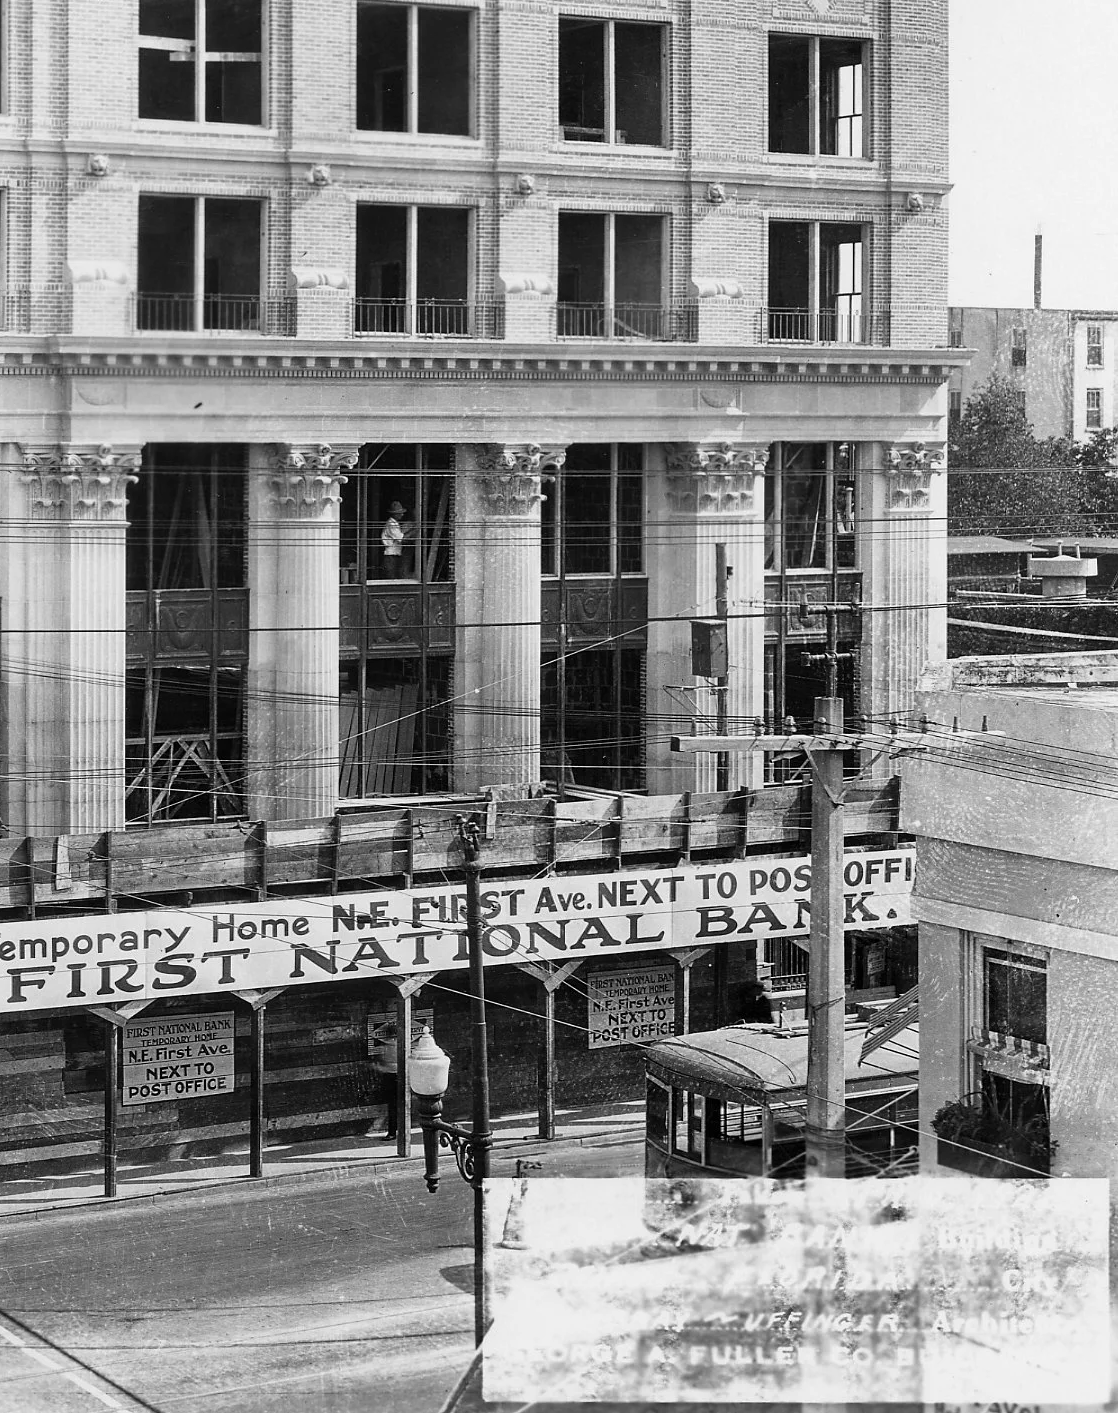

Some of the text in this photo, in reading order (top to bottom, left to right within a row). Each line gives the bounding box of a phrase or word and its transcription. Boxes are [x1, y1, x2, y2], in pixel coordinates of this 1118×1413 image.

[212, 913, 311, 943] Home
[332, 900, 400, 933] N.E.
[412, 889, 525, 928] FIRST
[534, 886, 593, 914] Ave.
[597, 876, 685, 908] NEXT
[695, 871, 738, 900] TO
[749, 864, 811, 896] POS
[843, 857, 912, 887] OFFI
[6, 947, 251, 1004] FIRST
[289, 913, 665, 978] NATIONAL
[590, 972, 674, 989] FIRST NATIONAL BAN
[606, 984, 670, 998] TEMPORARY HOME
[593, 1000, 616, 1013] N.E.
[618, 996, 650, 1010] First
[608, 1009, 666, 1026] NEXT TO
[126, 1020, 232, 1038] FIRST NATIONAL BANK
[593, 1021, 675, 1043] POST OFFICE
[142, 1033, 217, 1047] TEMPORARY HOME
[129, 1050, 153, 1063] N.E.
[156, 1045, 192, 1060] First
[146, 1062, 215, 1081] NEXT TO
[129, 1077, 227, 1098] POST OFFICE
